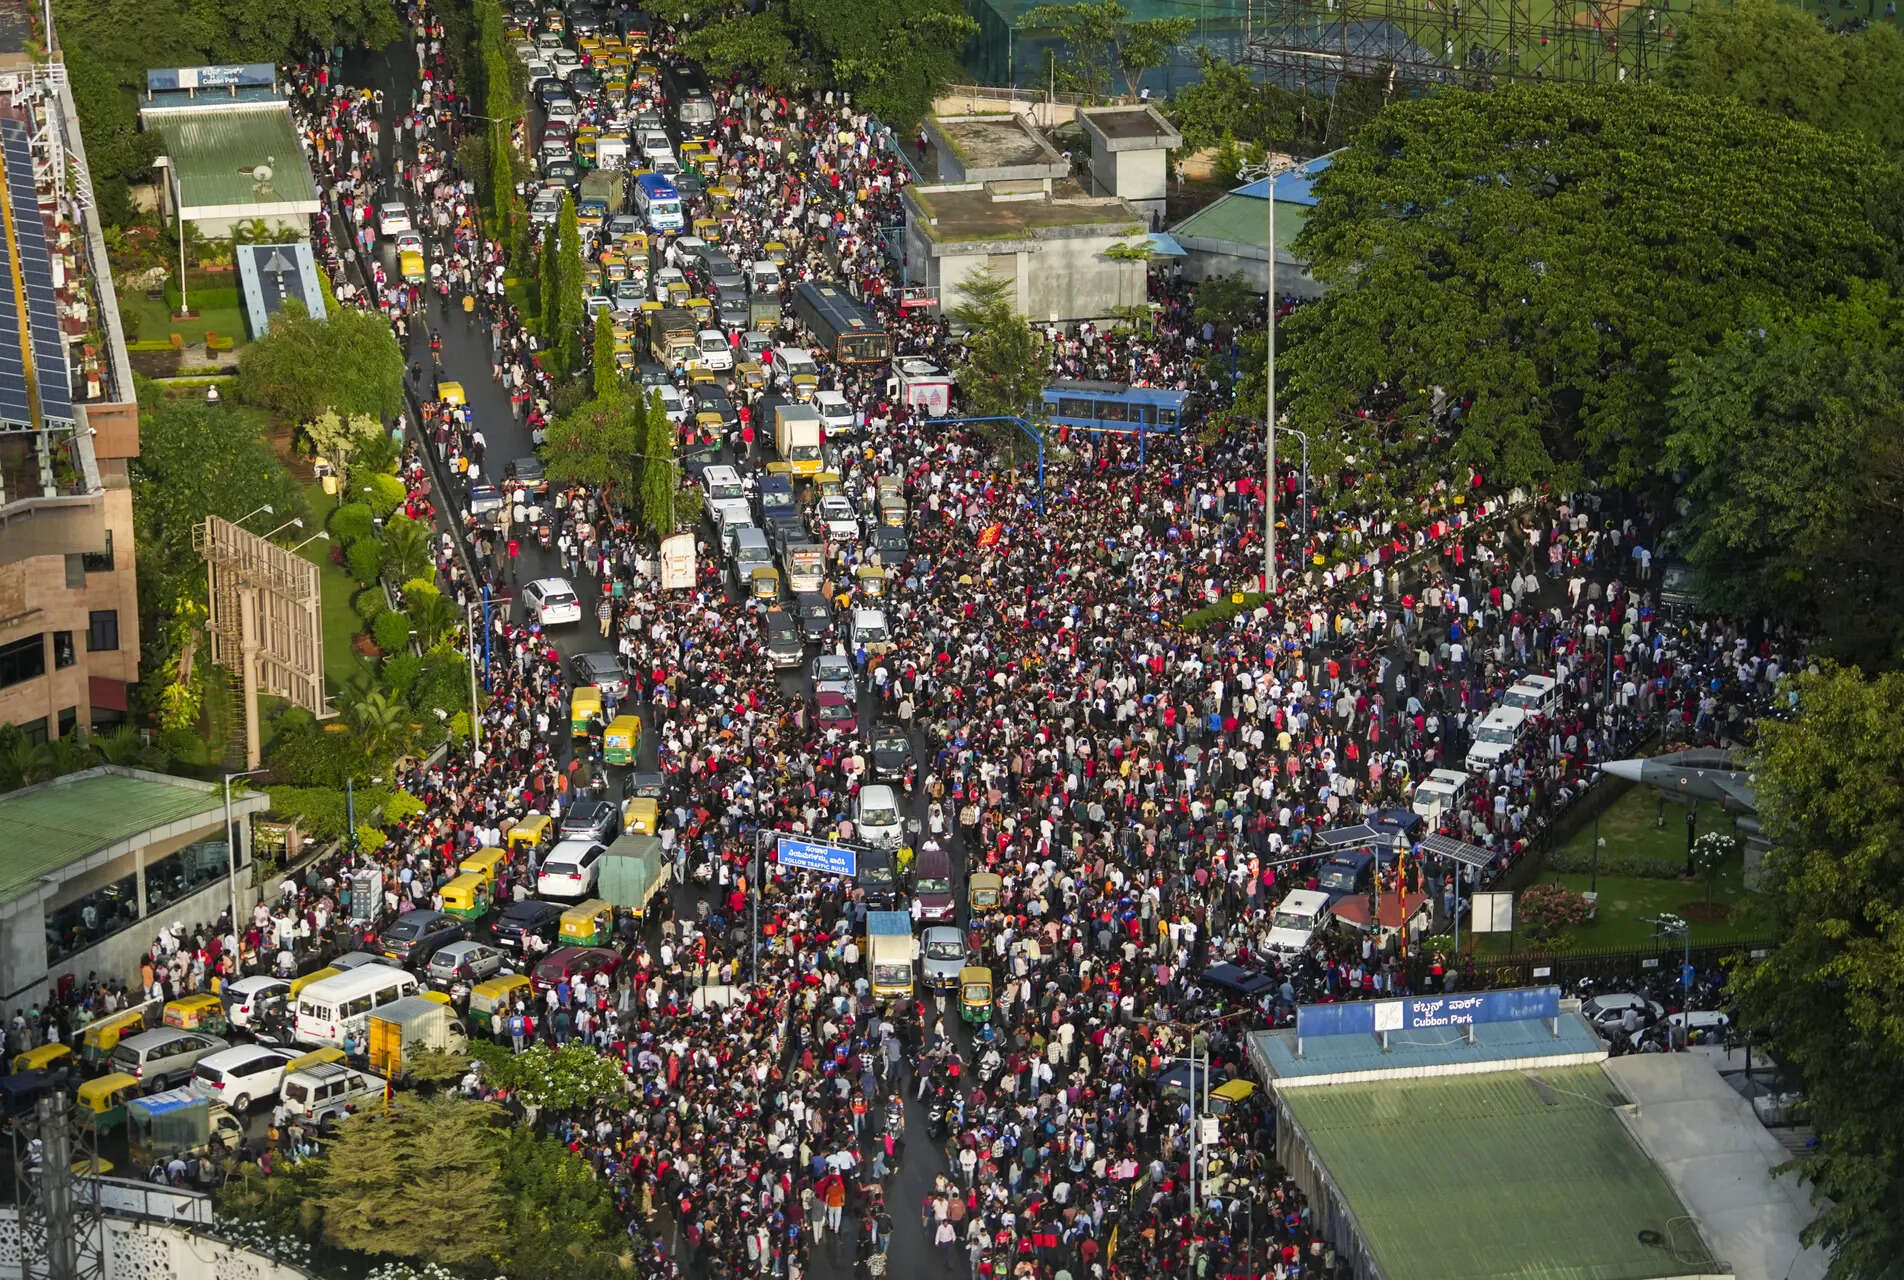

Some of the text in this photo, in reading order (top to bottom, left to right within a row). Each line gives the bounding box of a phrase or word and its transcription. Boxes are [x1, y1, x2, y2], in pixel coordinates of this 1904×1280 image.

[784, 856, 849, 874] FOLLOW TRAFFIC RULES
[1413, 1000, 1444, 1017] ಕಬ್ಬನ್
[1413, 1013, 1473, 1027] Cubbon Park
